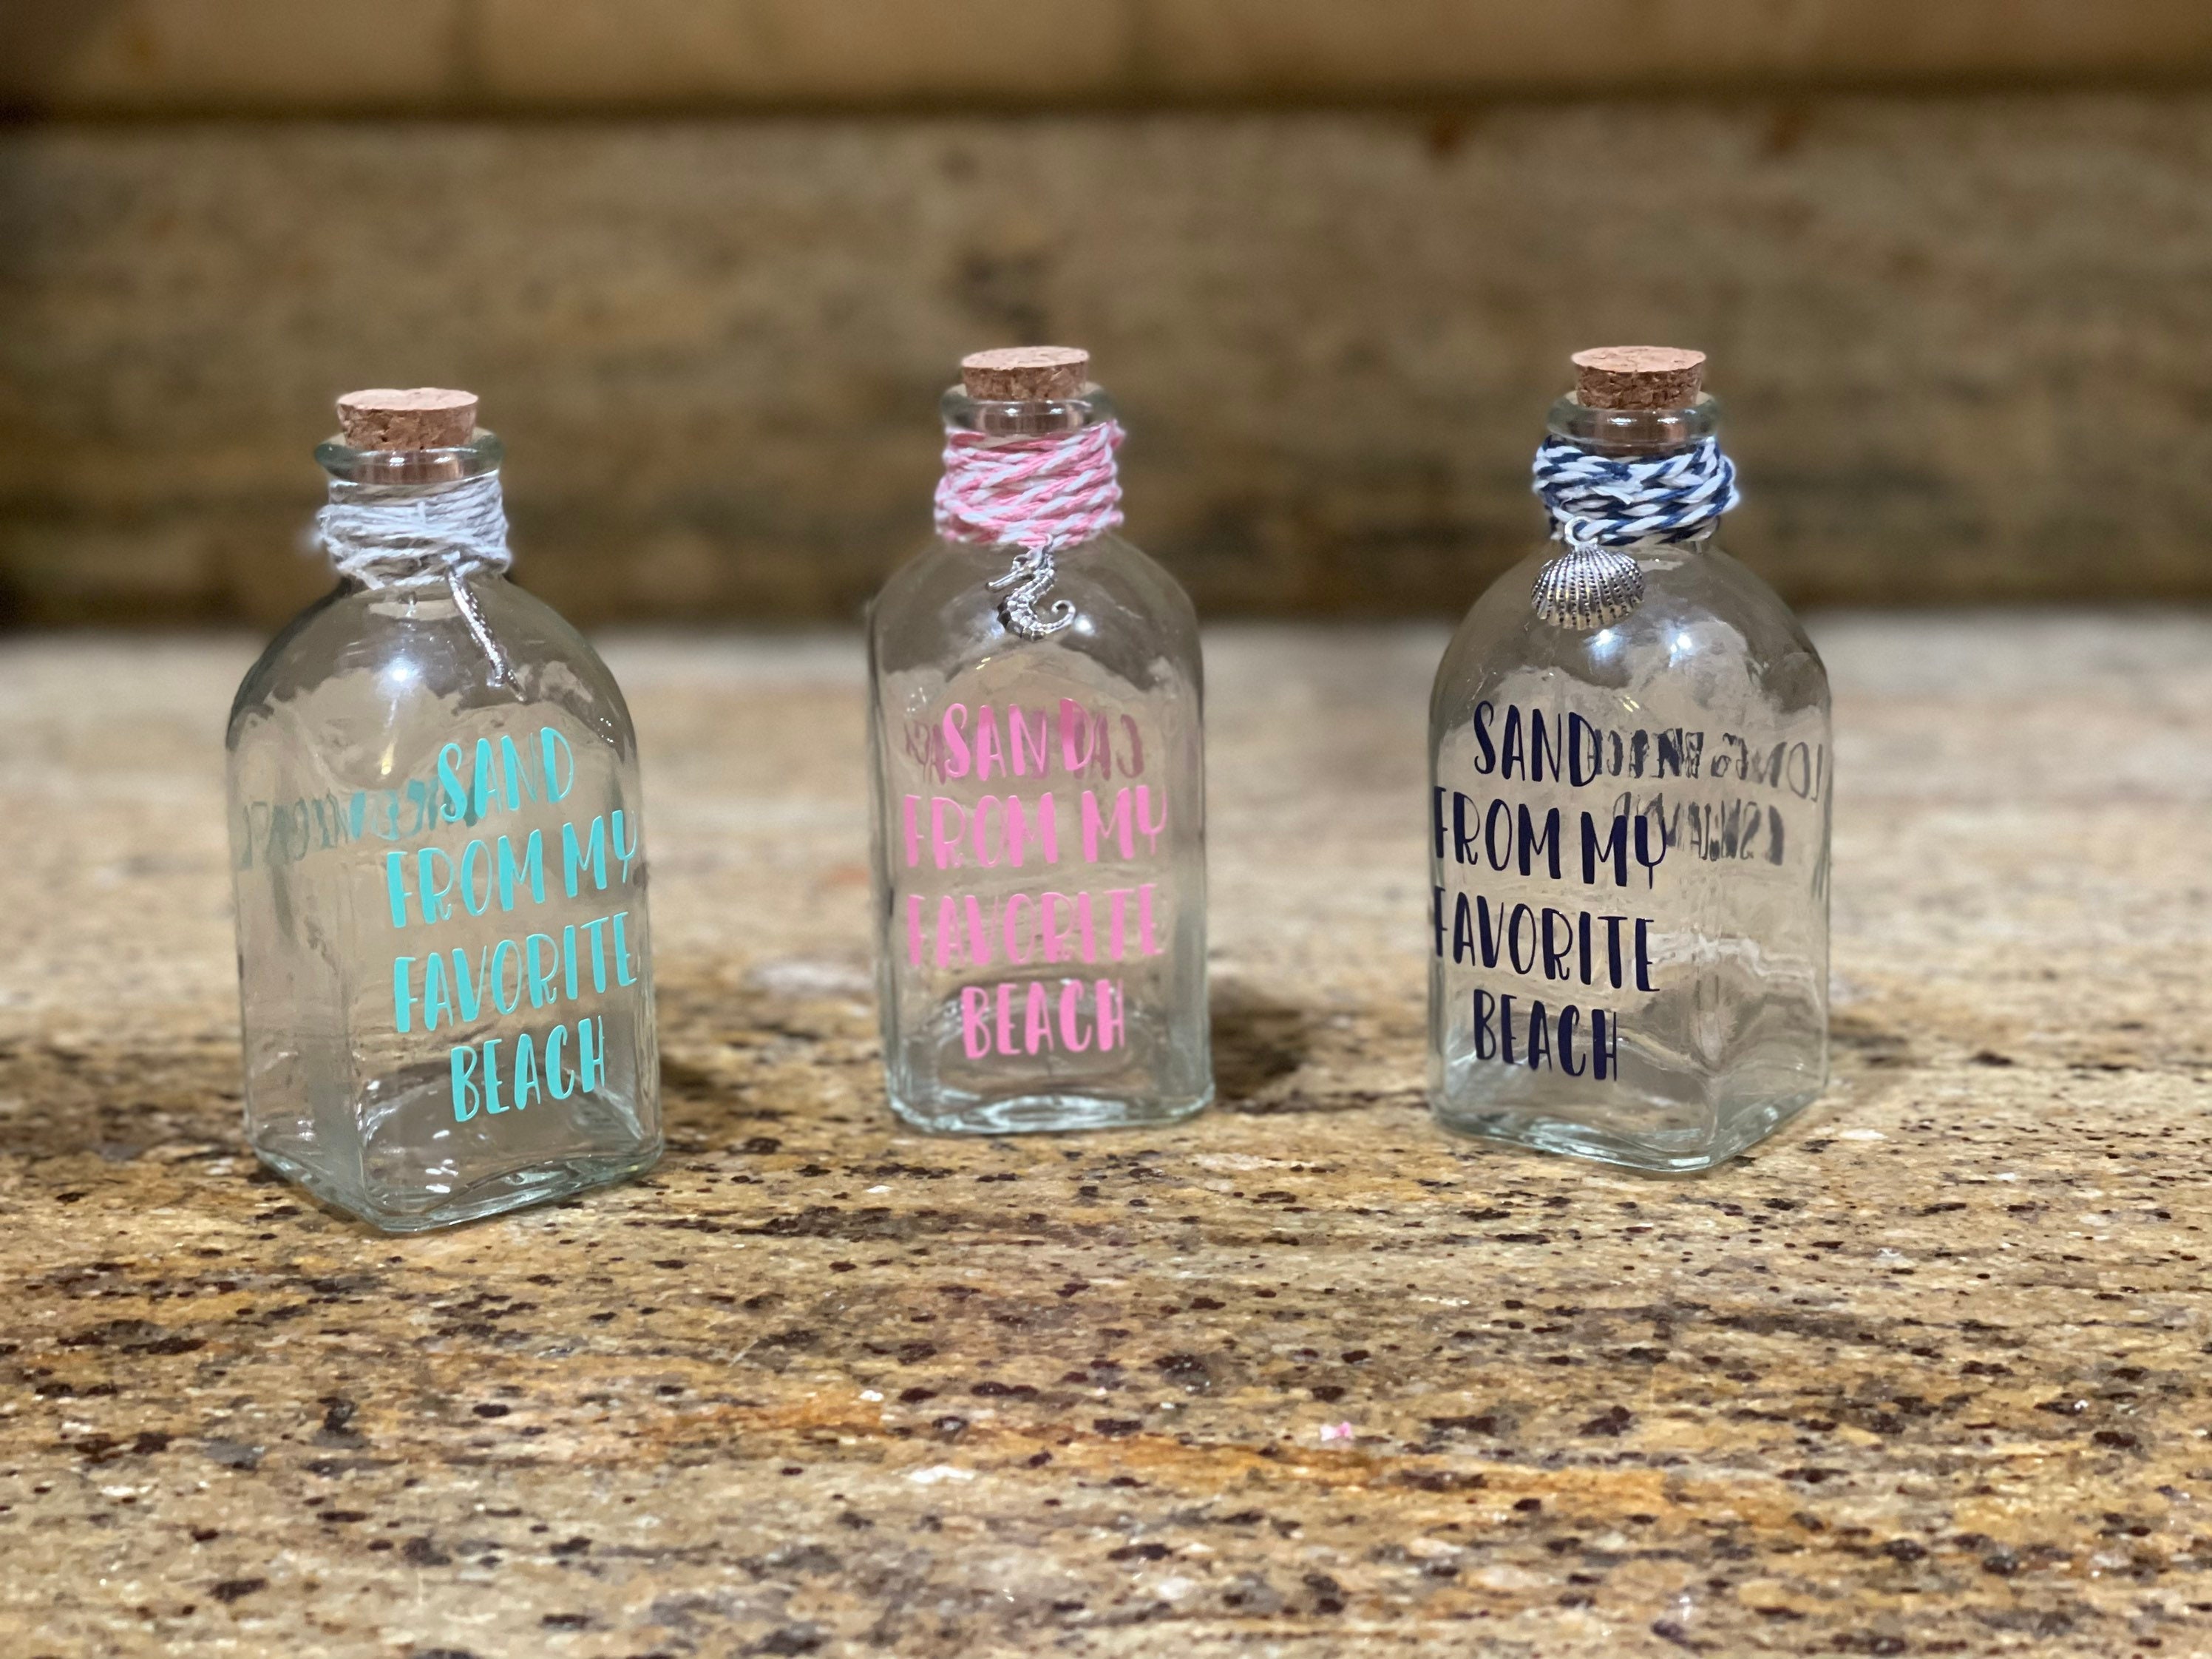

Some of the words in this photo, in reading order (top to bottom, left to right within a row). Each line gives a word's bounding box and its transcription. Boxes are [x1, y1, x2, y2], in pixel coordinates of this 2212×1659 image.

[438, 727, 574, 822] SAND
[943, 698, 1094, 781] SAND
[1473, 700, 1601, 787] SAND
[387, 829, 545, 928] FROM
[563, 810, 637, 898] MY
[903, 792, 1058, 869] FROM
[1082, 785, 1167, 863] MY
[1434, 786, 1561, 879] FROM
[1581, 811, 1667, 889] MY
[393, 912, 637, 1033] FAVORITE
[906, 883, 1165, 968] FAVORITE
[1434, 885, 1660, 991] FAVORITE
[962, 978, 1125, 1059] BEACH
[1473, 988, 1618, 1081] BEACH
[450, 1015, 605, 1122] BEACH
